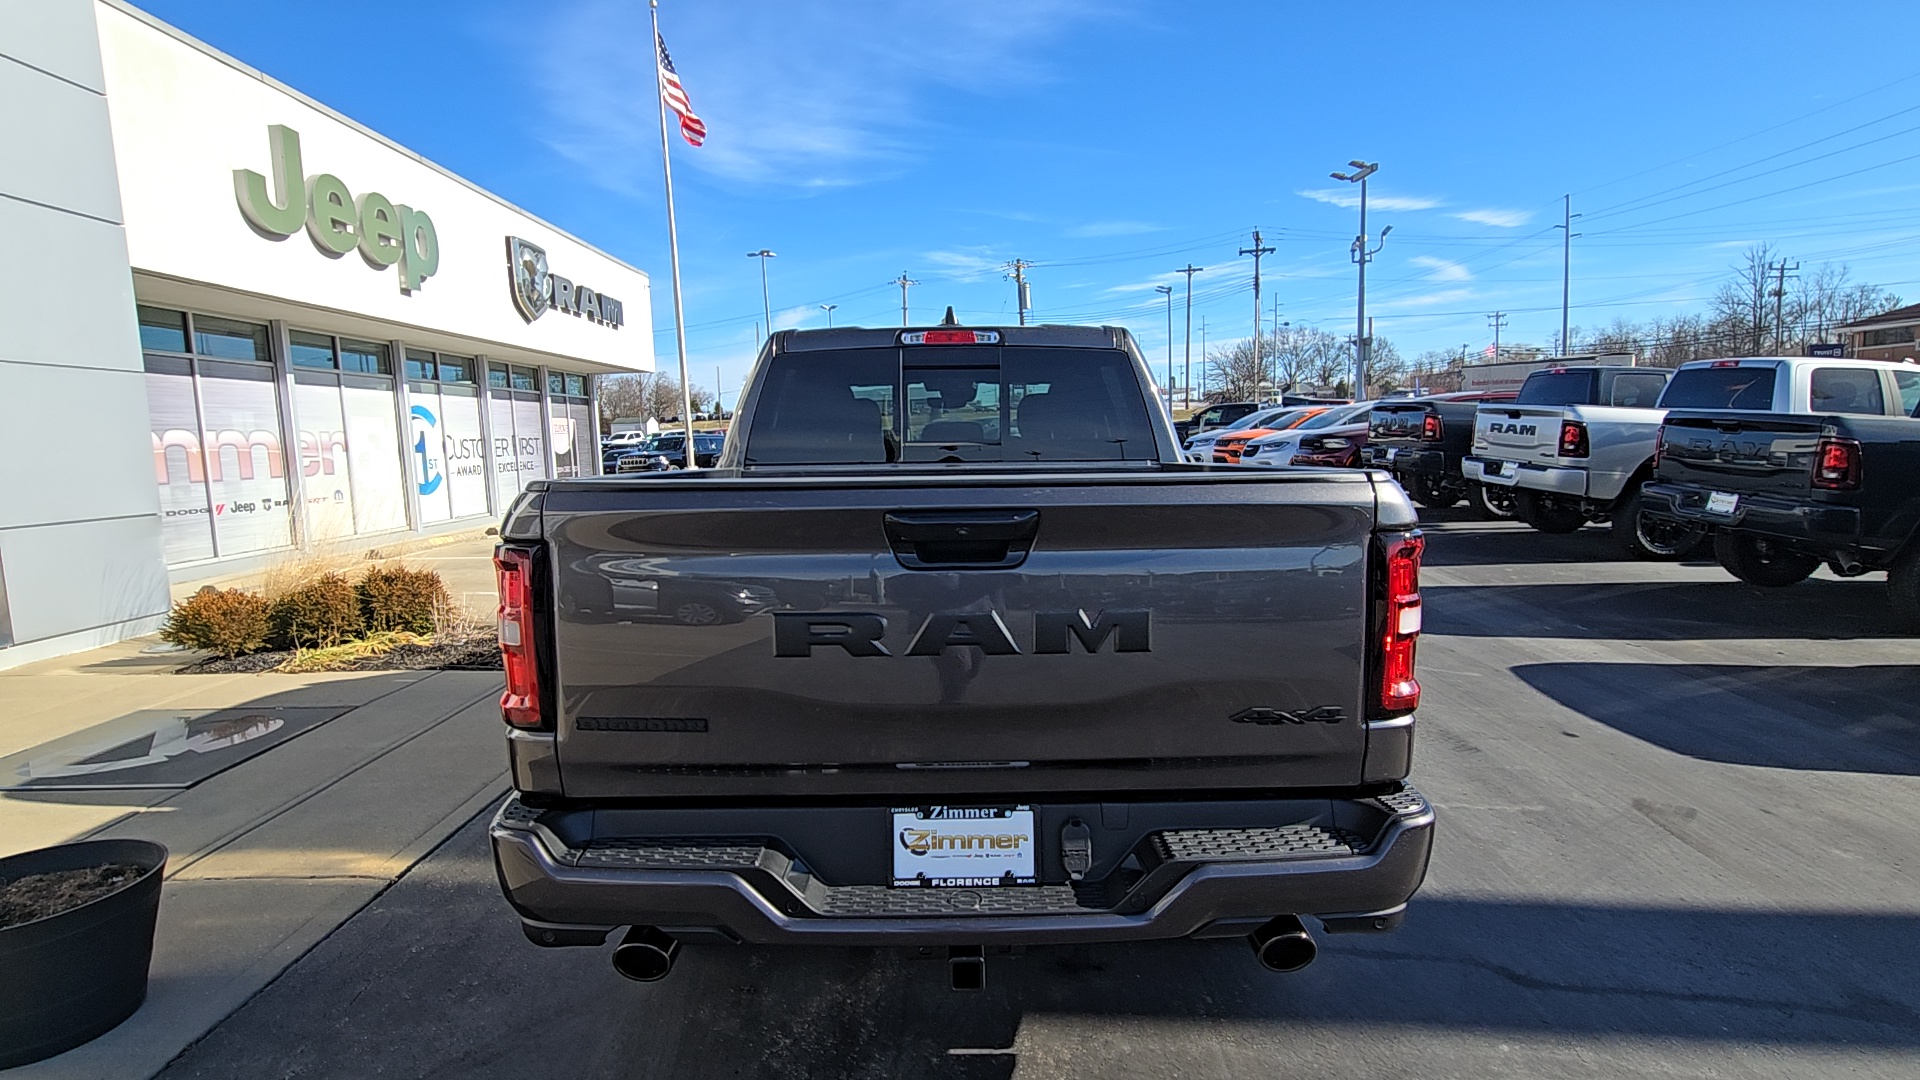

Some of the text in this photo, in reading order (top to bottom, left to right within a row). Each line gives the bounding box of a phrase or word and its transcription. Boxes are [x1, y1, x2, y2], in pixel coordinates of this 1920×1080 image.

[233, 124, 439, 296] Jeep
[548, 273, 624, 331] RAM
[1490, 422, 1537, 436] RAM
[1687, 438, 1771, 458] RAM
[457, 465, 482, 476] AWARD
[498, 461, 534, 473] EXCELENCE
[165, 508, 212, 517] DODG
[230, 500, 256, 513] Jeep
[772, 607, 1153, 658] RAM
[930, 805, 998, 819] Zimmer
[907, 829, 1029, 851] Zimmer
[931, 877, 1000, 887] FLORENCE
